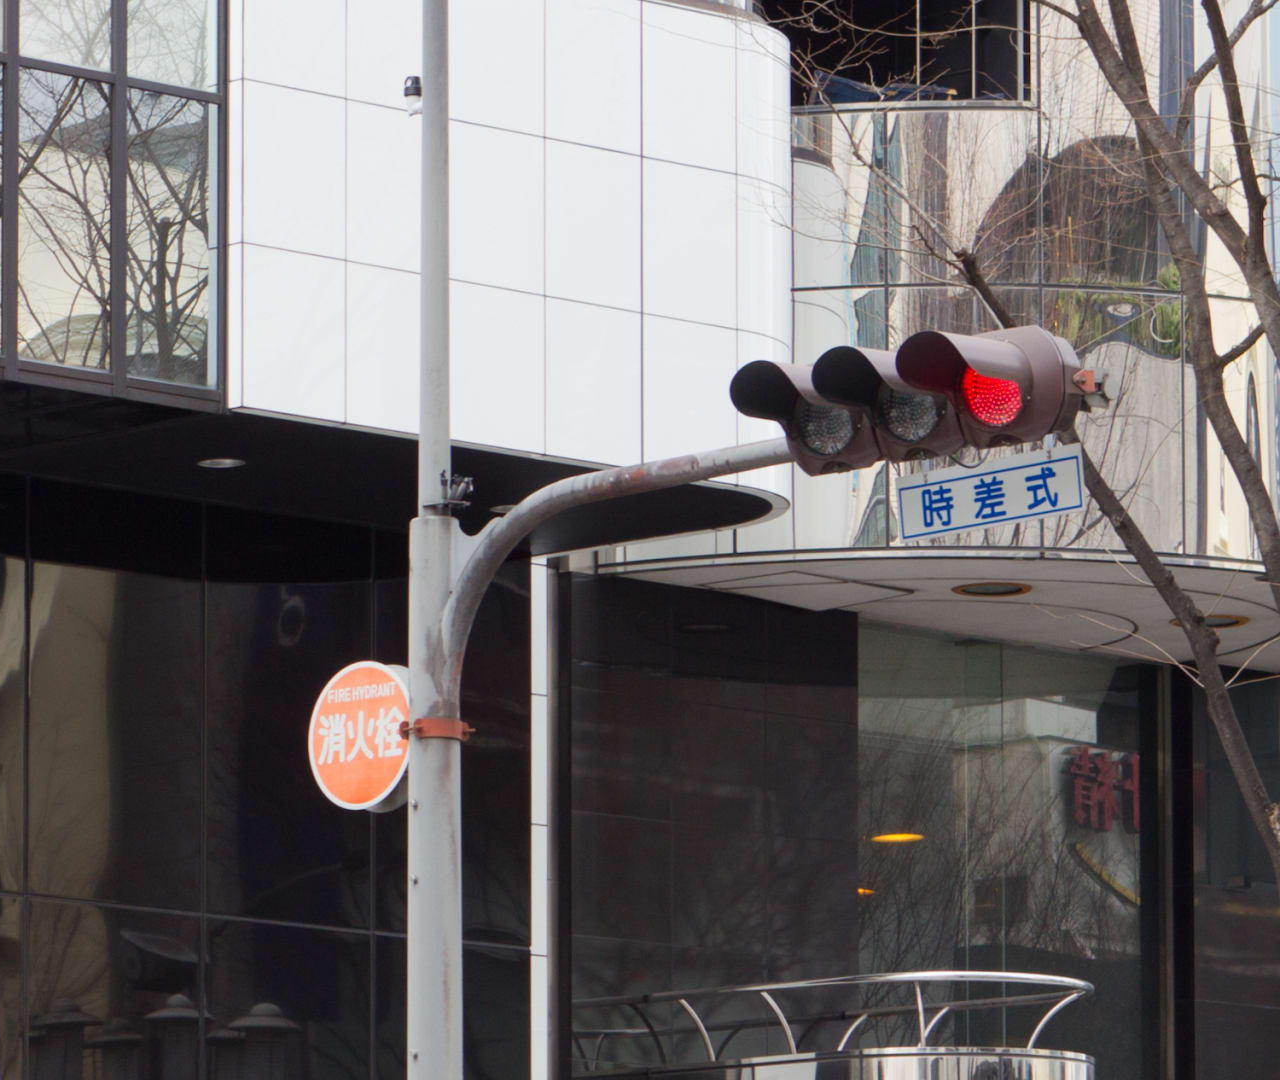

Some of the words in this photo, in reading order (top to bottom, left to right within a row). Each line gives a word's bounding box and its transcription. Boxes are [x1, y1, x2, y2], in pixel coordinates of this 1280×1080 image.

[921, 466, 1059, 527] 時差式
[328, 688, 351, 703] FIRE
[352, 682, 397, 700] HYDRANT
[318, 706, 407, 766] 消火栓
